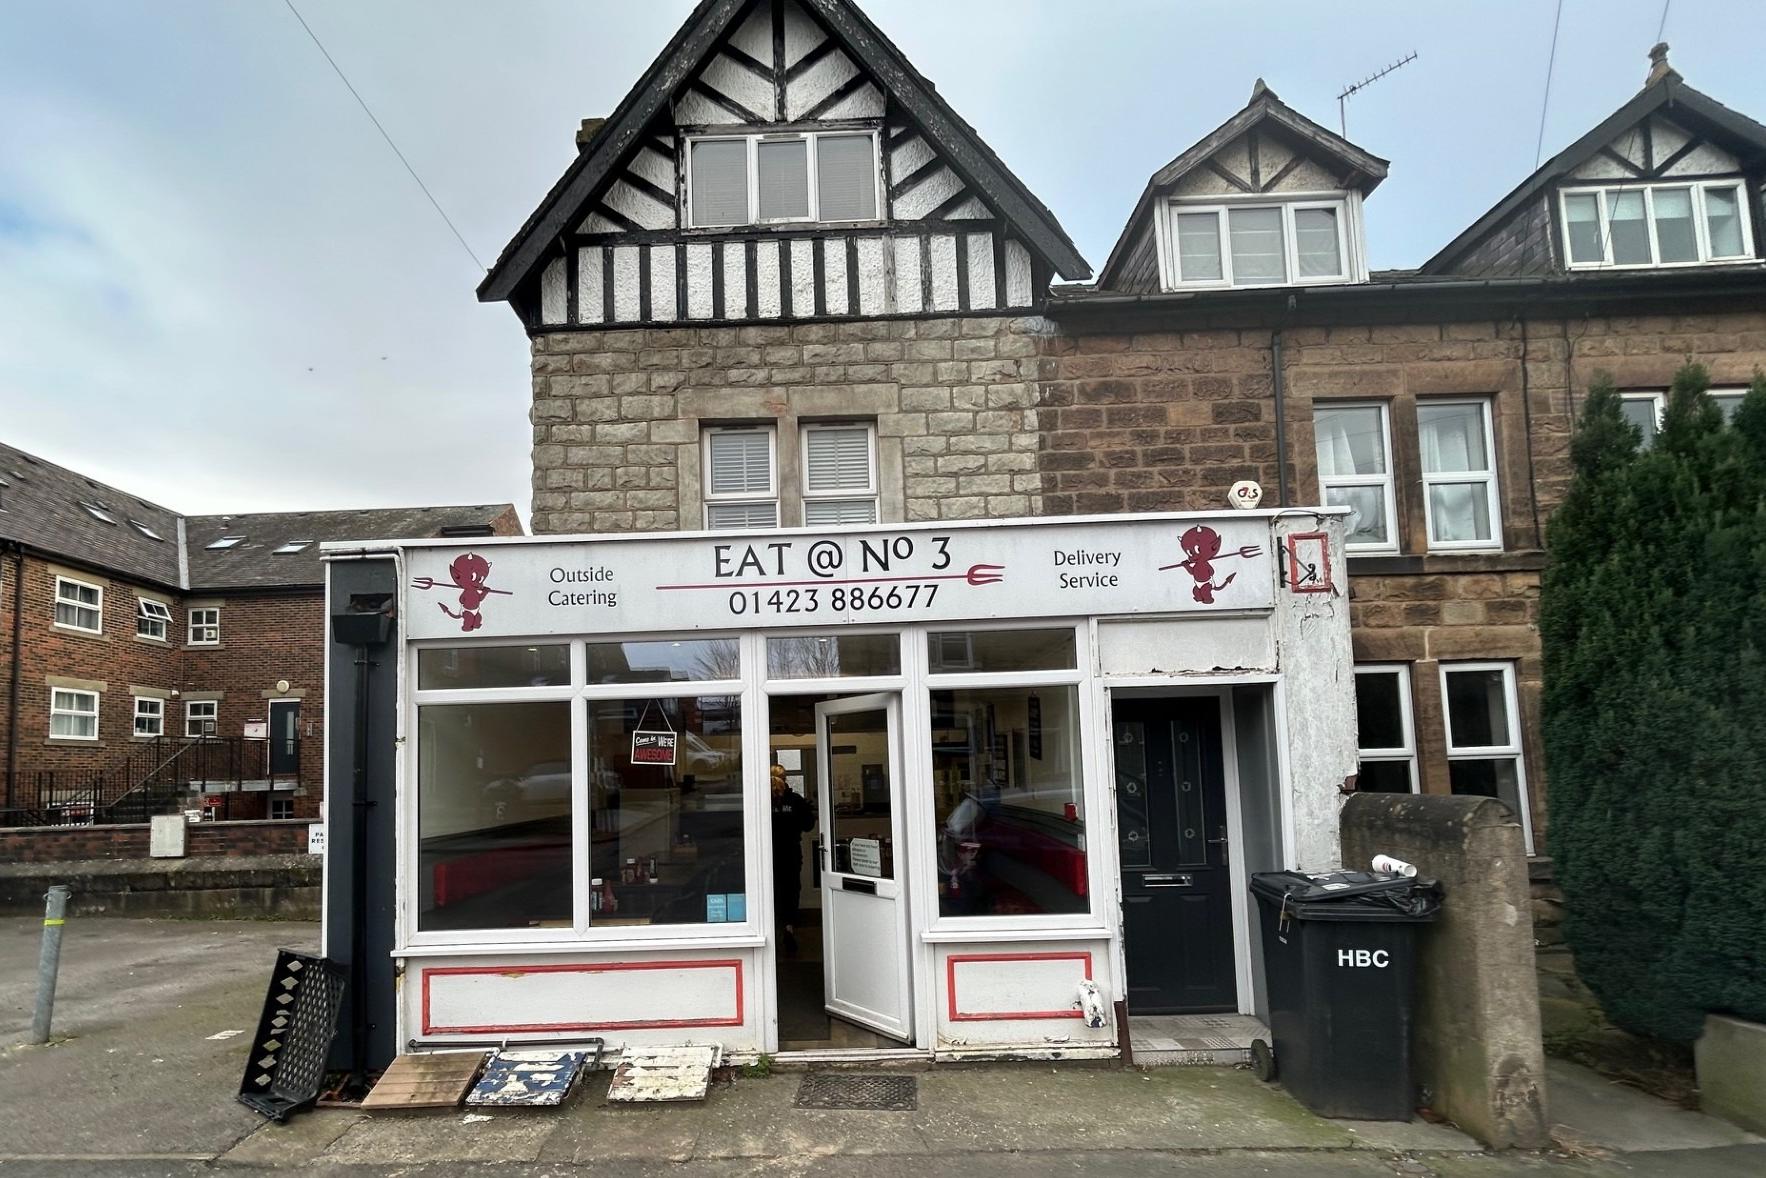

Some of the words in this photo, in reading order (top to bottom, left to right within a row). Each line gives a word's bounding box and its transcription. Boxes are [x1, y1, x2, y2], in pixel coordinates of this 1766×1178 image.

[714, 542, 793, 578] EAT
[807, 539, 843, 578] @
[931, 536, 951, 570] 3
[1053, 549, 1121, 567] Delivery
[549, 566, 614, 583] Outside
[1059, 571, 1119, 589] Service
[548, 589, 617, 608] Catering
[729, 588, 819, 615] 01423
[831, 584, 939, 612] 886677
[634, 748, 673, 761] AWESOME
[1338, 949, 1389, 968] HBC
